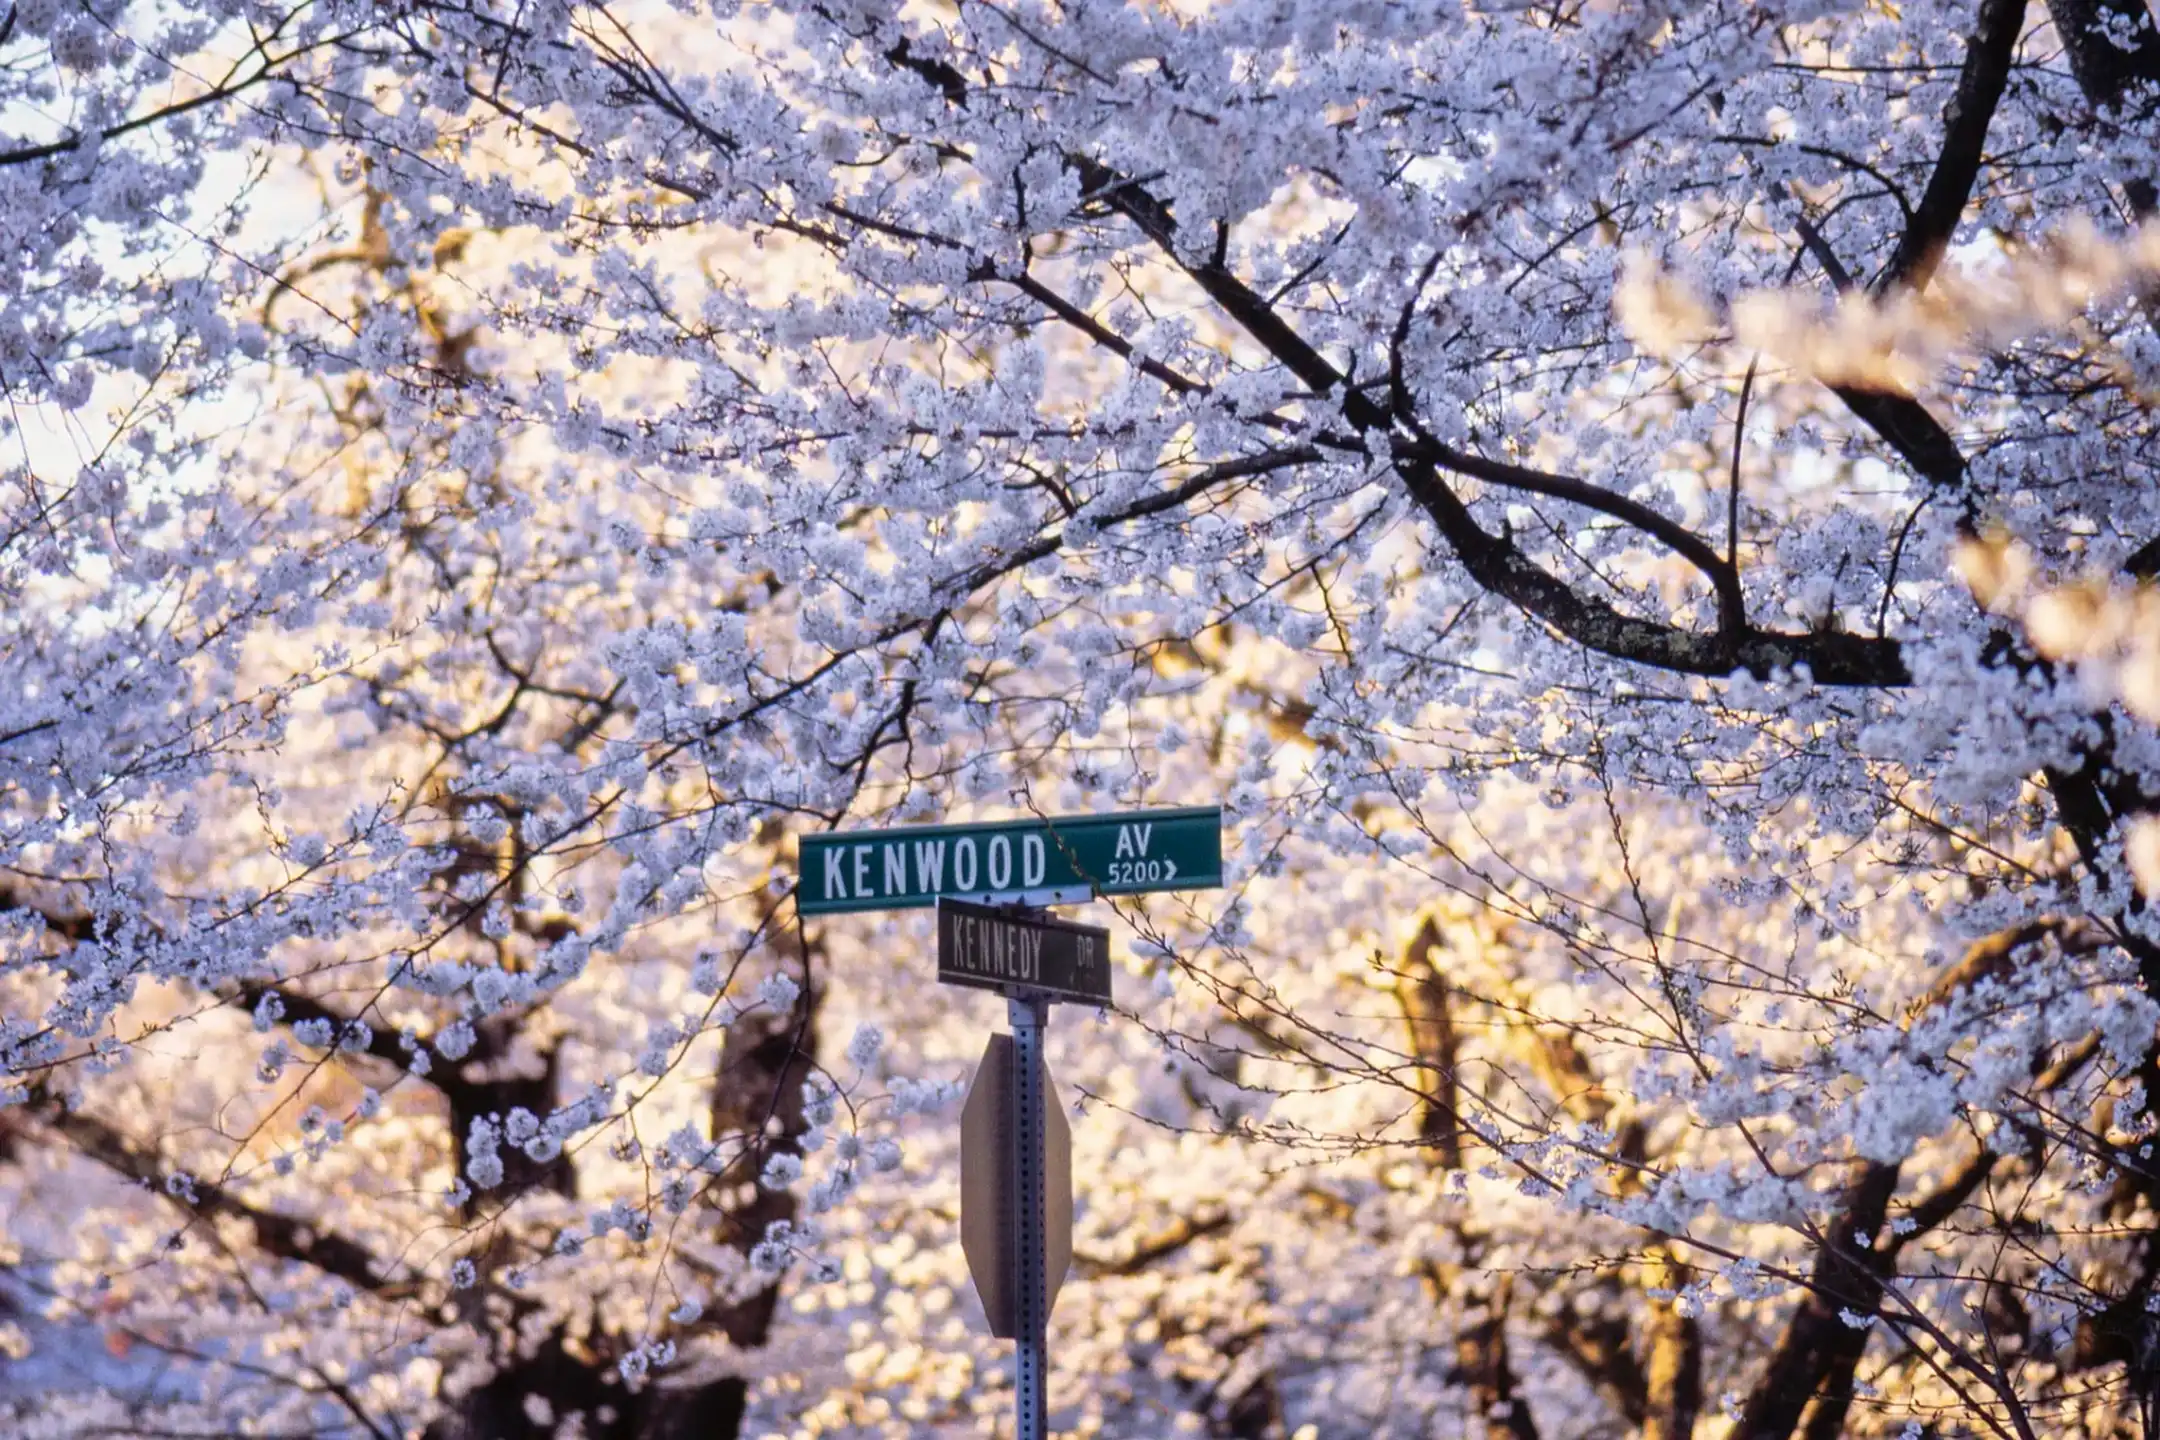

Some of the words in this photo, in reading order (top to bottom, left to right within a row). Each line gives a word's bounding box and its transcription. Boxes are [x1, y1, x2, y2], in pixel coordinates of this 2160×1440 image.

[824, 834, 1046, 899] KENWOOD
[1115, 823, 1152, 859] AV
[1108, 860, 1160, 885] 5200
[953, 914, 1042, 981] KENNEDY
[1076, 934, 1094, 968] DR
